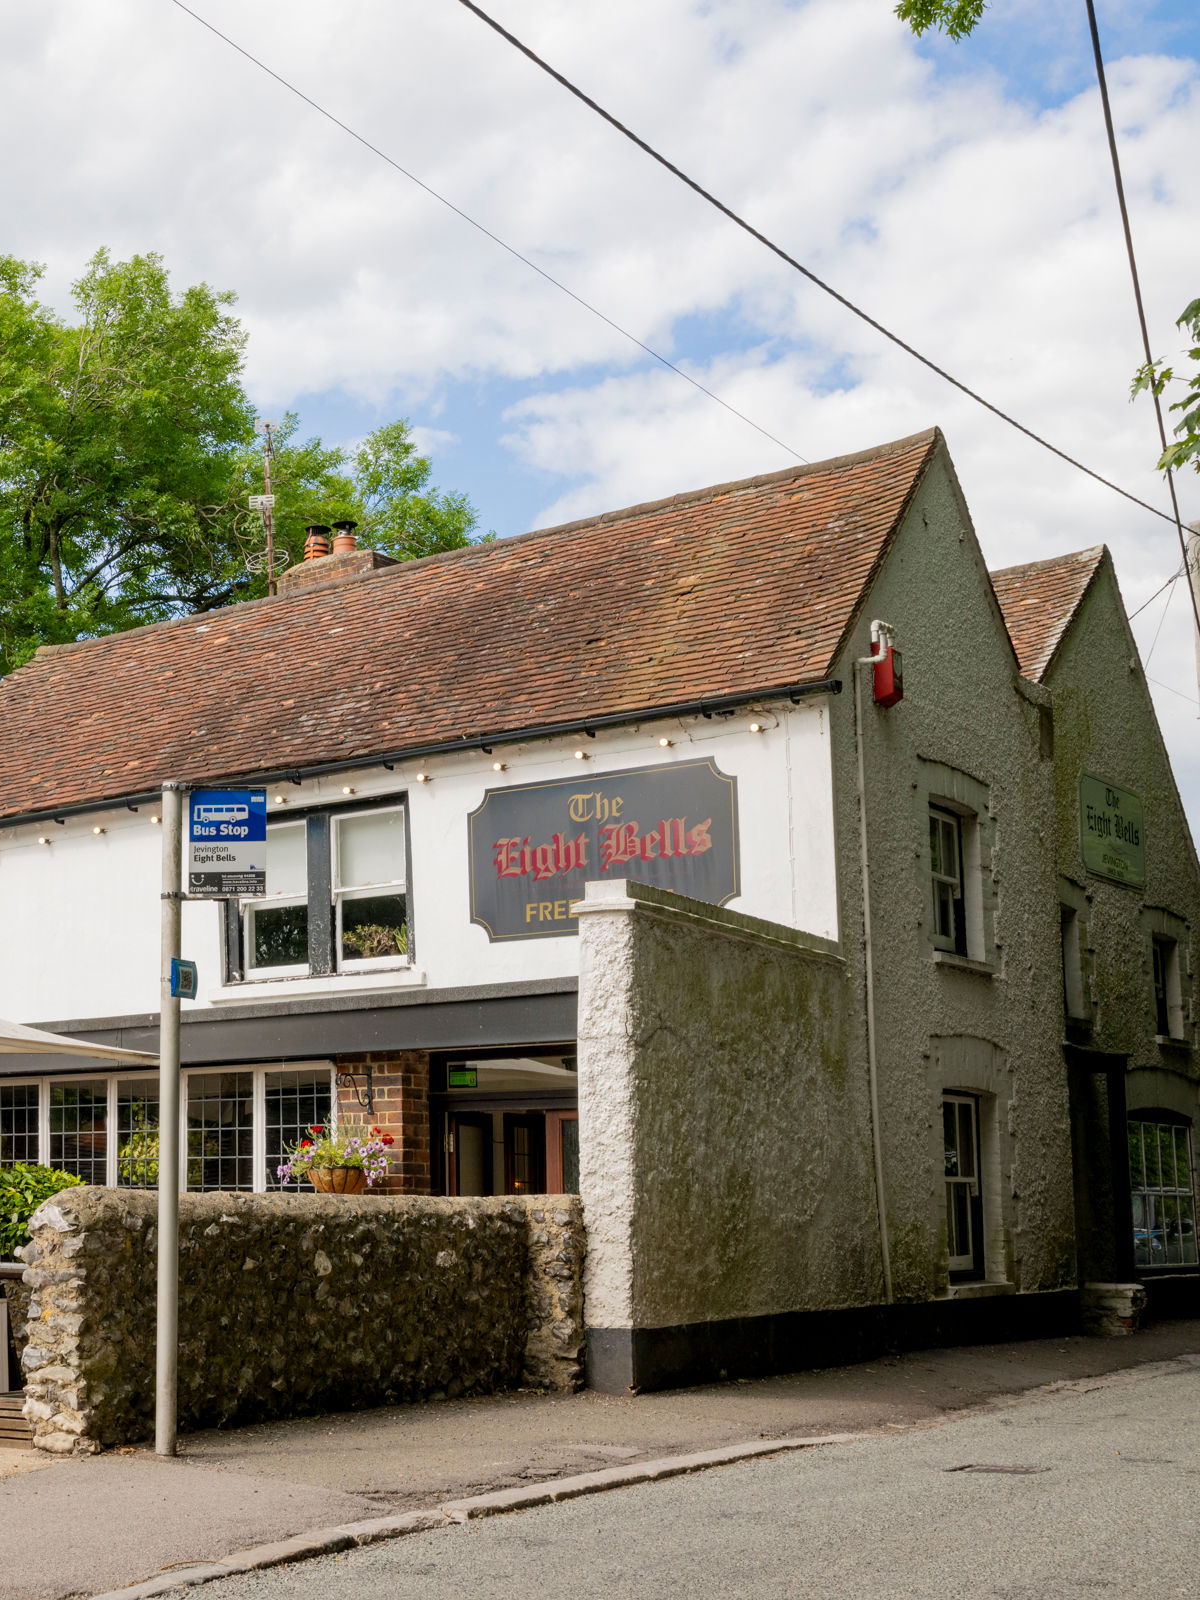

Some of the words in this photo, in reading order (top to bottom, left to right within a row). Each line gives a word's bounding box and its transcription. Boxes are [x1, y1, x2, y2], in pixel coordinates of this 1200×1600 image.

[568, 791, 624, 825] The
[1105, 787, 1120, 810] The
[193, 825, 217, 835] Bus
[220, 824, 249, 838] Stop
[1086, 804, 1112, 838] Eight
[1114, 813, 1139, 846] Bells
[193, 845, 229, 854] Jevington
[193, 854, 215, 863] Eight
[216, 854, 236, 862] Bells
[492, 831, 590, 882] Eight
[597, 816, 712, 872] Bells
[525, 898, 581, 923] FREE
